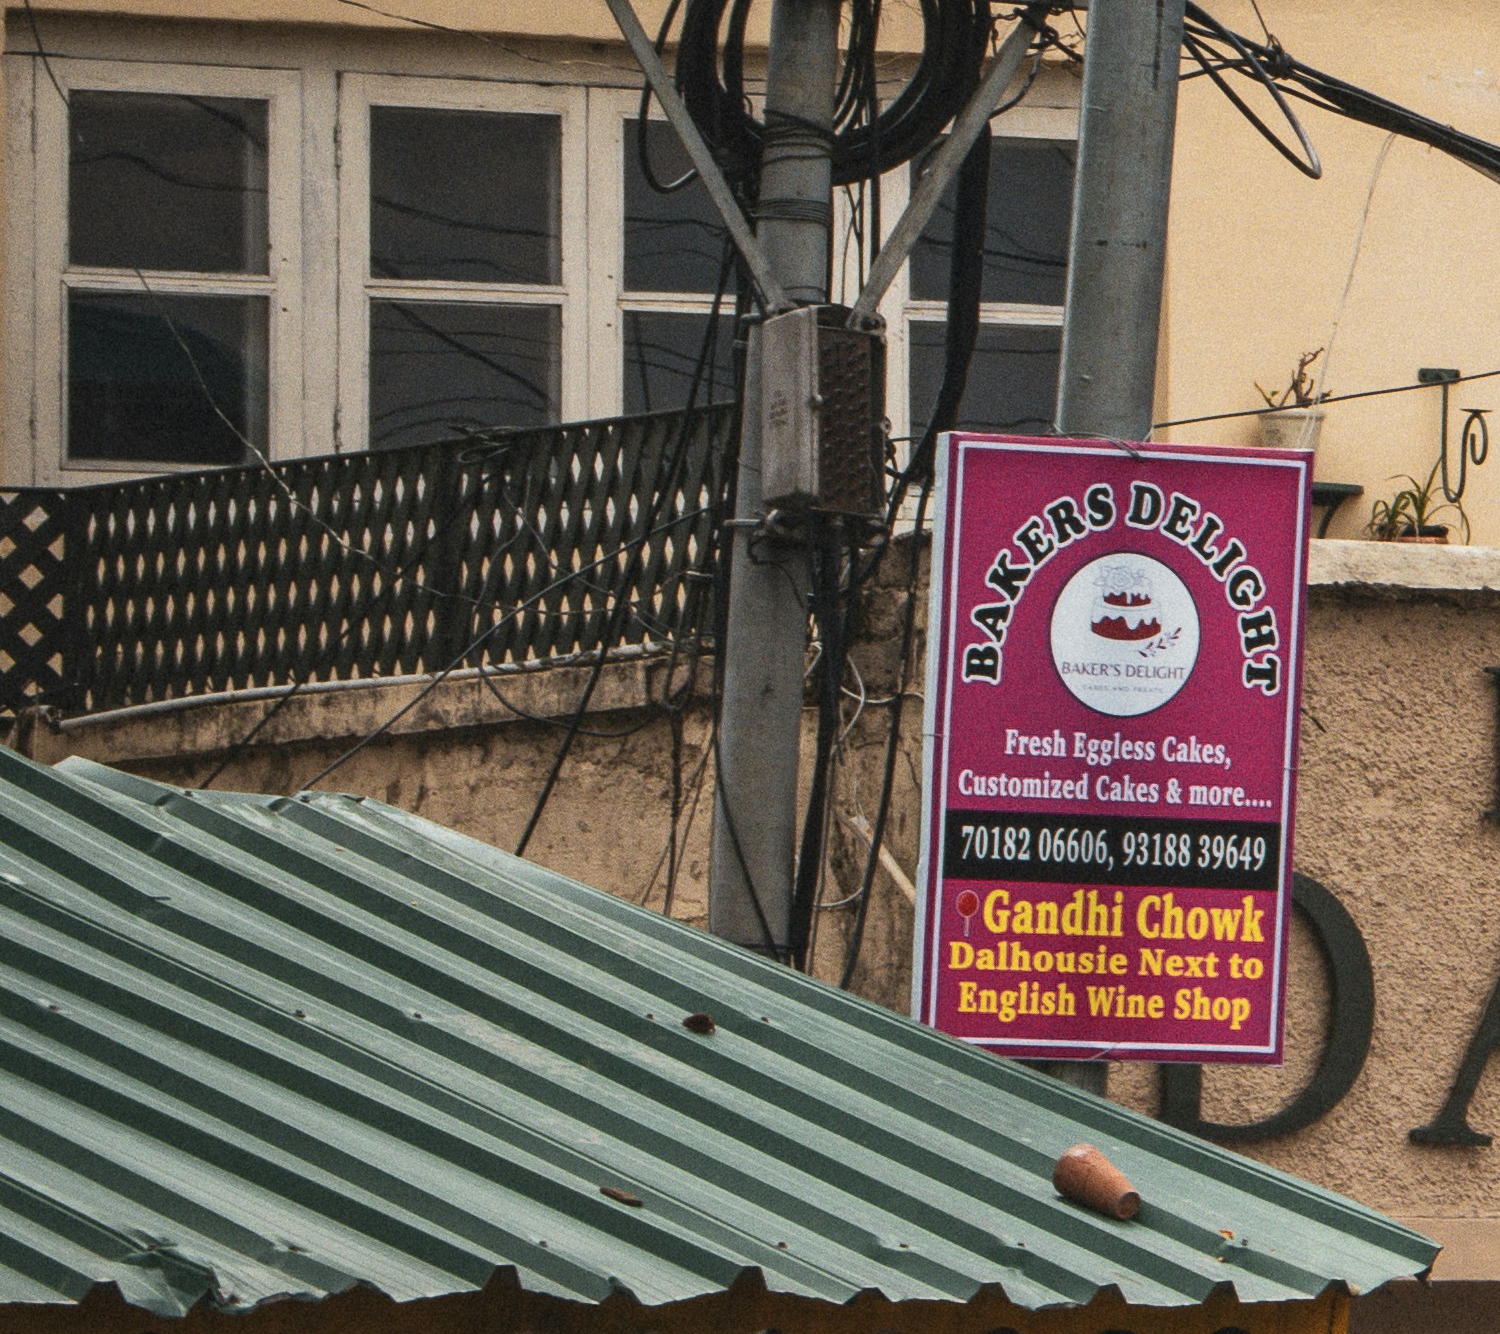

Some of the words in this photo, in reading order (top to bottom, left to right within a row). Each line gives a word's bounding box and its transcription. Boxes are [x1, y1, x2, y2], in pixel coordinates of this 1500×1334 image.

[964, 483, 1113, 684] BAKERS
[1126, 481, 1282, 694] DELIGHT
[1061, 661, 1122, 677] BAKER'S
[1125, 665, 1187, 680] DELIGHT
[1003, 729, 1067, 758] Fresh
[1073, 732, 1156, 765] Eggless
[1162, 736, 1232, 770] Cakes,
[957, 769, 1089, 800] Customized
[1095, 775, 1159, 804] Cakes
[1165, 778, 1182, 805] &
[1188, 783, 1273, 808] more....
[960, 824, 1031, 861] 70182
[1038, 827, 1115, 872] 06606,
[1122, 832, 1191, 868] 93188
[1197, 834, 1267, 872] 39649
[983, 888, 1124, 937] Gandhi
[1136, 892, 1265, 943] Chowk
[948, 940, 1128, 975] Dalhousie
[1137, 948, 1220, 978] Next
[1228, 953, 1264, 980] to
[957, 981, 1077, 1023] English
[1087, 986, 1165, 1018] Wine
[1173, 988, 1252, 1030] Shop
